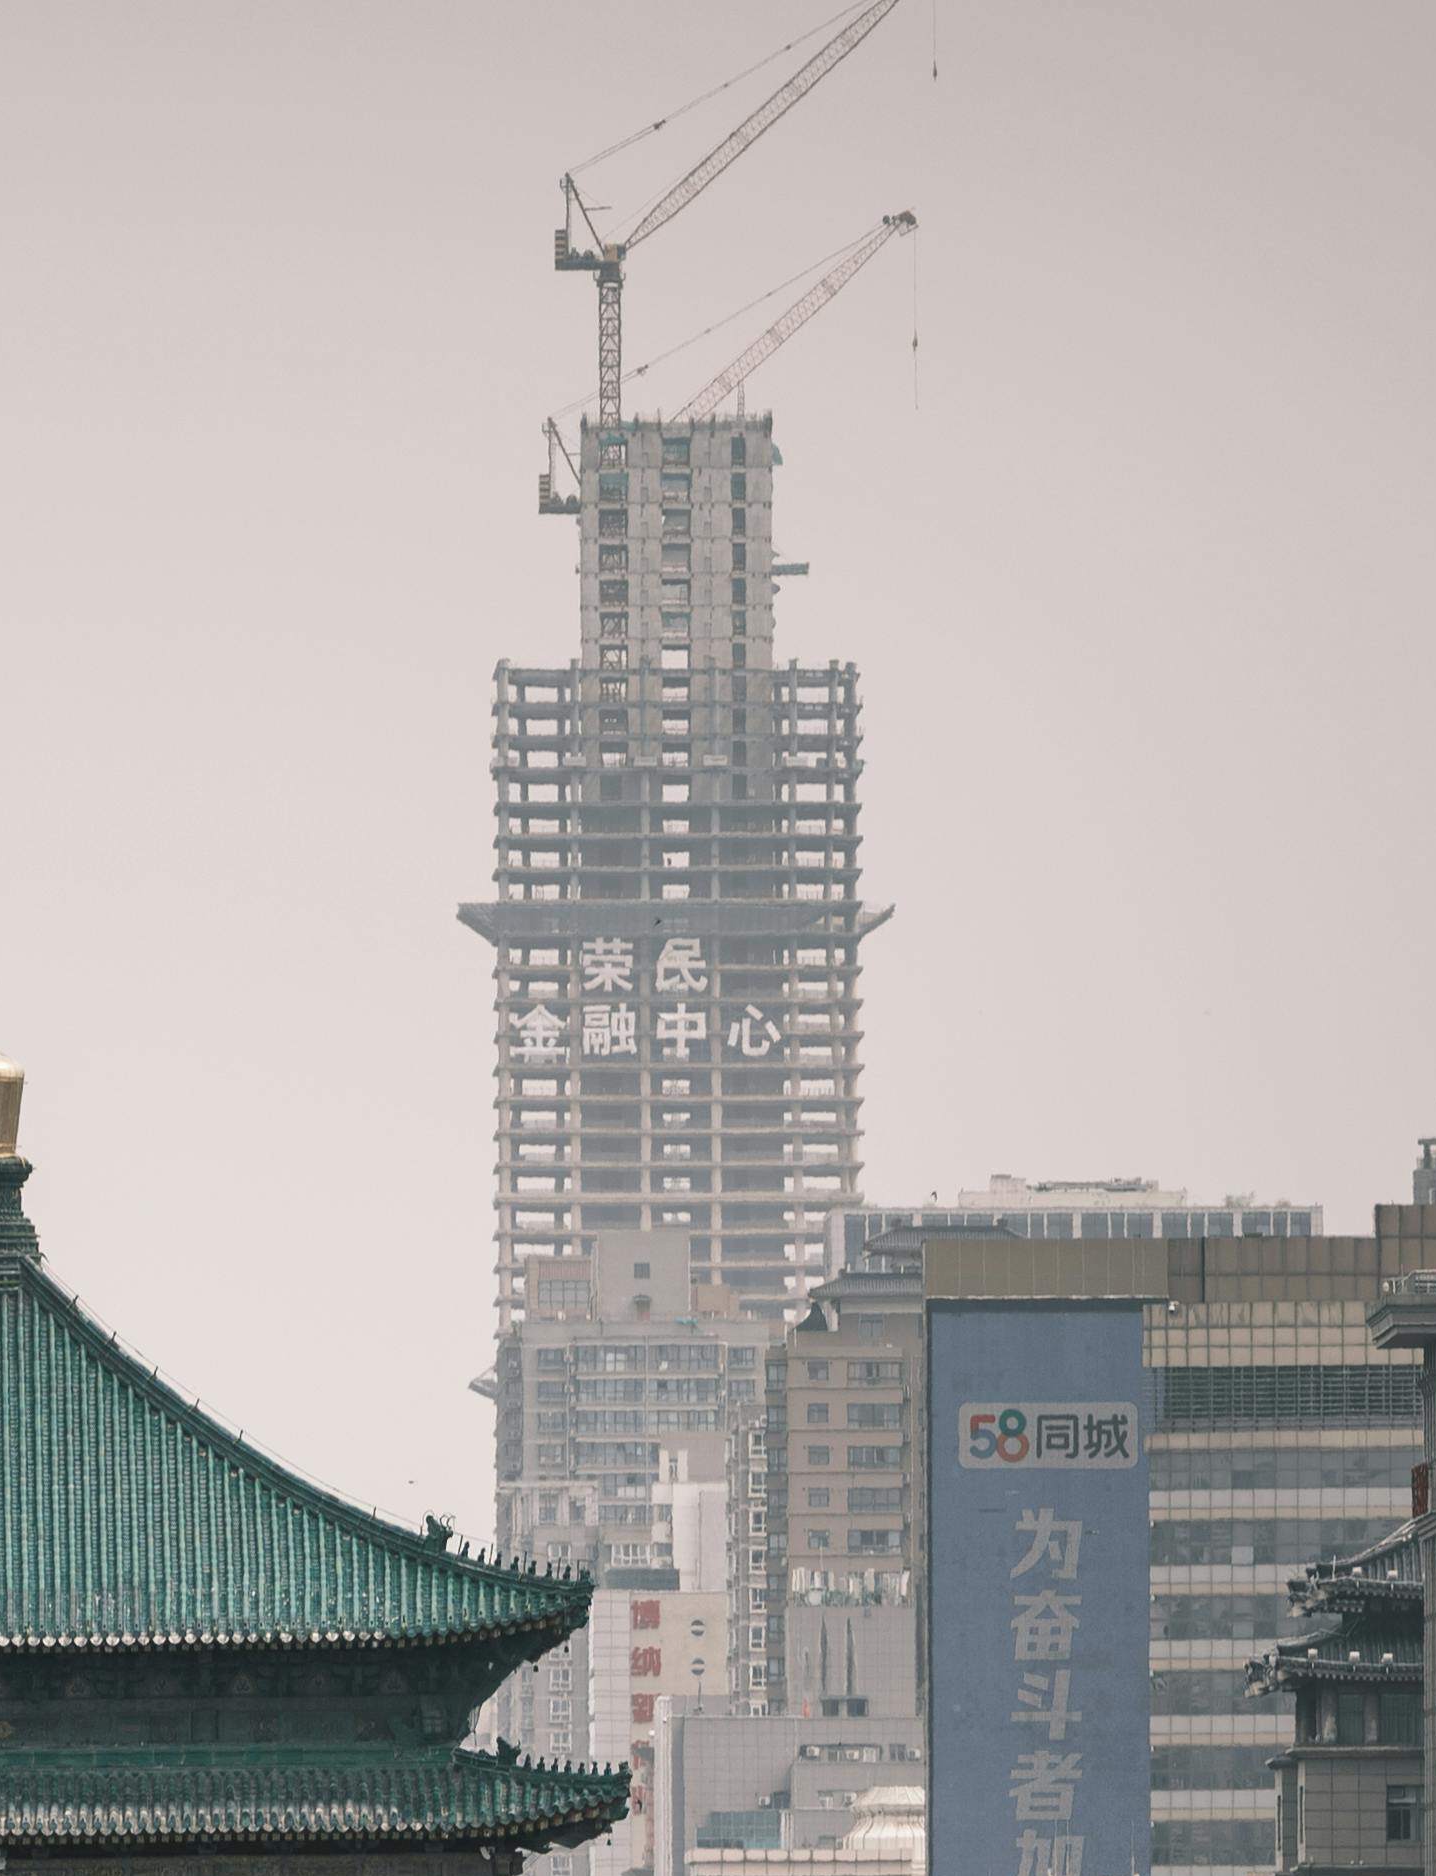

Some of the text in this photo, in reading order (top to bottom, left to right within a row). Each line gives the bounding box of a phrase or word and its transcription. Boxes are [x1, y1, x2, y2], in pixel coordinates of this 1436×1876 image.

[582, 937, 708, 992] 荣民
[510, 1002, 782, 1058] 金融中心
[970, 1408, 1130, 1463] 58同城
